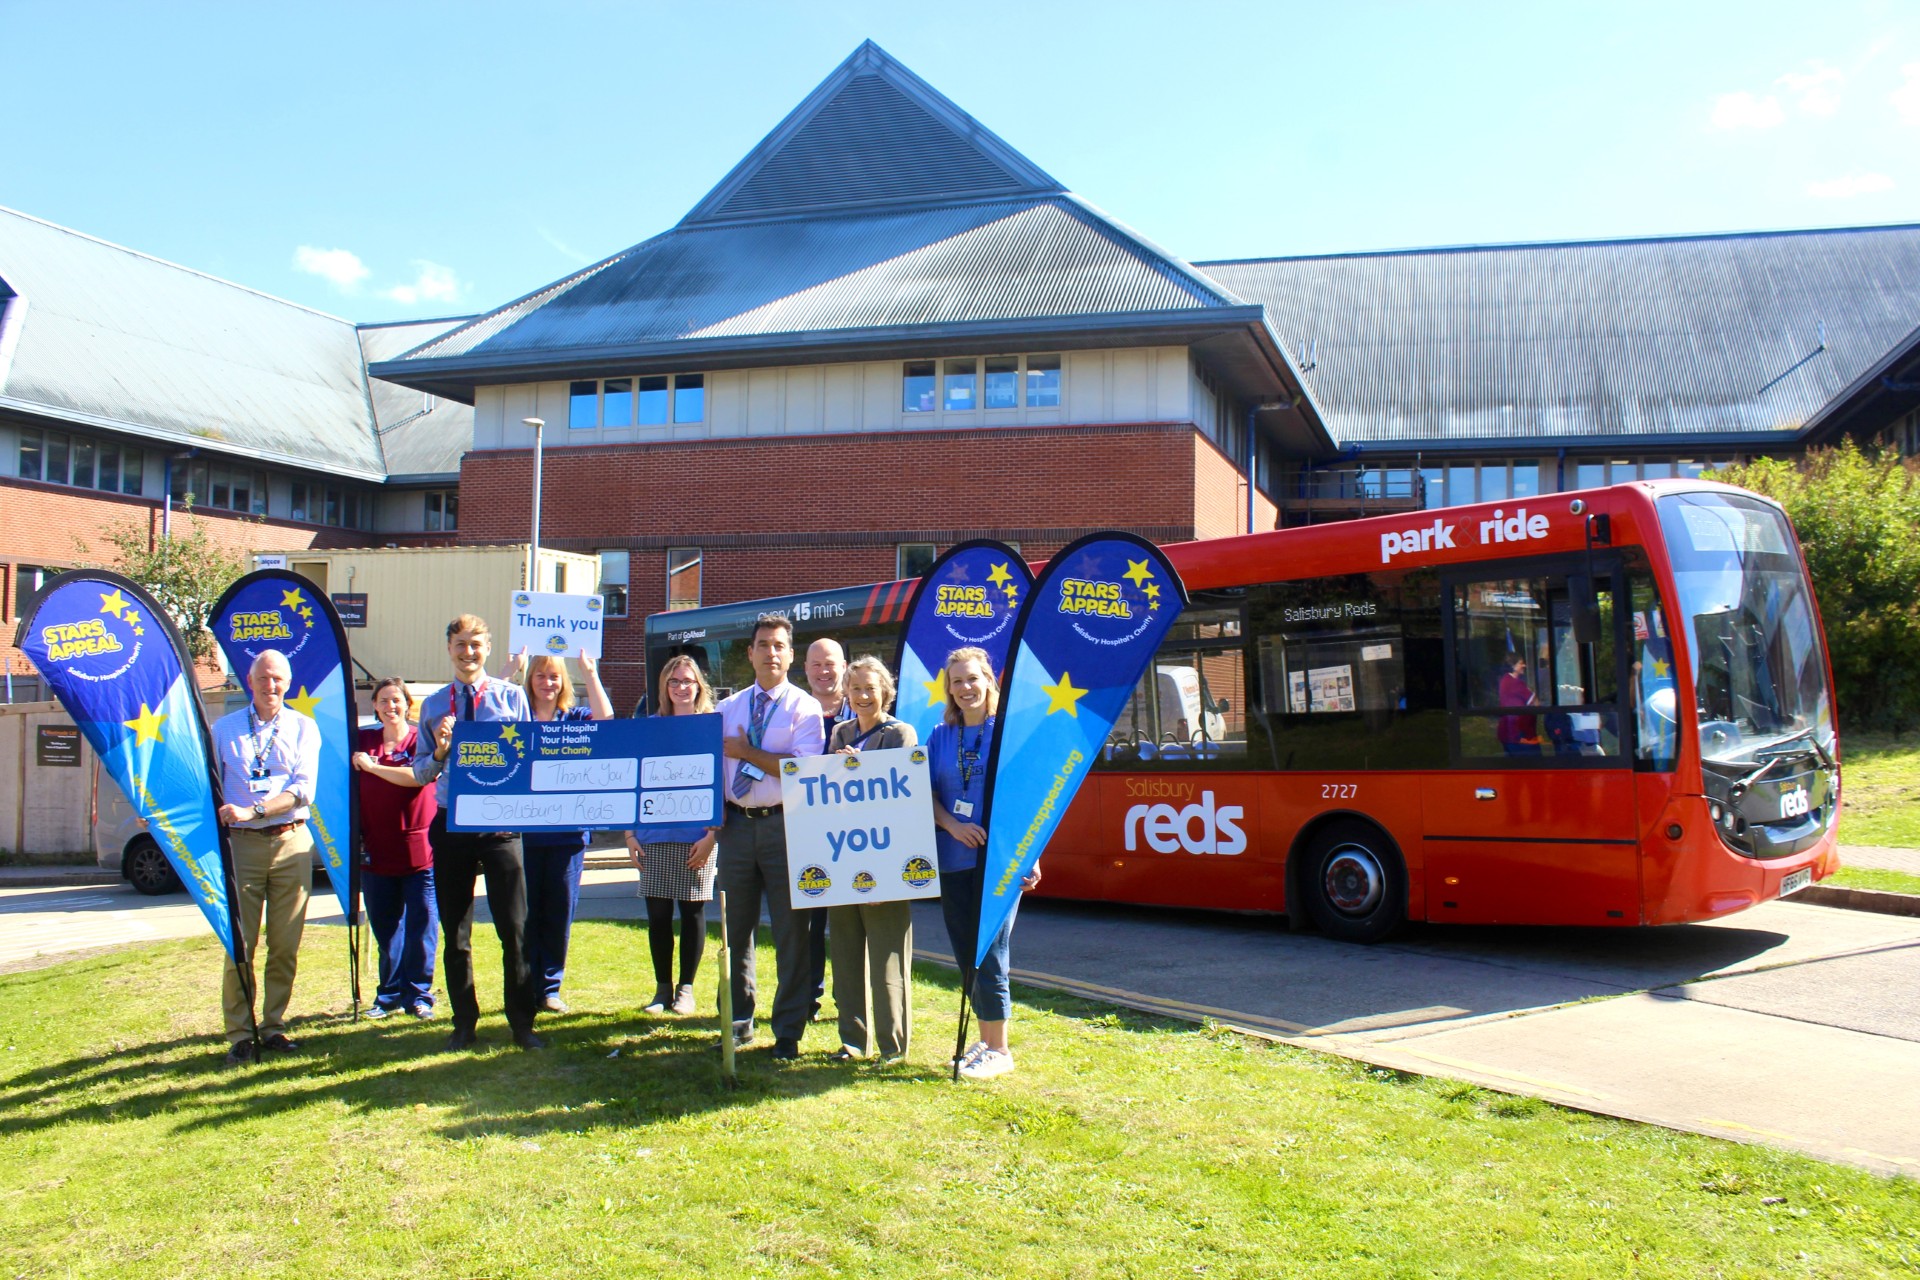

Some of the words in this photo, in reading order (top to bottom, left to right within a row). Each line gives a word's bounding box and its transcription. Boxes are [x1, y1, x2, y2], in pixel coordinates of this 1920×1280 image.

[1380, 518, 1456, 563] park
[1479, 508, 1549, 545] ride
[937, 586, 985, 602] STARS
[1062, 579, 1120, 600] STARS
[792, 602, 811, 621] 15
[813, 600, 845, 619] mins
[936, 600, 993, 617] APPEAL
[1060, 596, 1131, 618] APPEAL
[1284, 606, 1342, 622] Salisbury
[1344, 601, 1377, 617] Reds
[231, 612, 280, 628] STARS
[517, 613, 565, 629] Thank
[570, 619, 599, 633] you
[945, 623, 968, 643] Salisbury
[968, 631, 997, 643] Hospital's
[995, 612, 1013, 633] Charity
[1072, 622, 1100, 645] Salisbury
[1100, 634, 1135, 646] Hospital's
[1133, 614, 1154, 636] Charity
[44, 619, 105, 644] STARS
[232, 624, 291, 640] APPEAL
[295, 632, 311, 651] Charity
[667, 632, 678, 640] Part
[677, 631, 683, 639] of
[49, 635, 122, 660] APPEAL
[67, 666, 99, 682] Salisbury
[99, 663, 131, 681] Hospital's
[128, 641, 143, 664] Charity
[540, 735, 560, 744] Your
[561, 734, 590, 744] Health
[541, 724, 561, 733] Your
[562, 723, 598, 734] Hospital
[459, 743, 498, 755] STARS
[540, 746, 559, 755] Your
[561, 746, 592, 756] Charity
[458, 754, 506, 766] APPEAL
[548, 762, 594, 785] Thank
[798, 766, 912, 807] Thank
[1125, 778, 1195, 801] Salisbury
[1321, 784, 1358, 799] 2727
[481, 795, 562, 824] Salisbury
[573, 795, 615, 821] Reds
[1780, 784, 1809, 818] reds
[992, 748, 1084, 897] www.starsappeal.org
[1124, 790, 1247, 855] reds
[132, 773, 220, 905] www.starsappeal.org
[826, 826, 891, 862] you
[797, 878, 832, 890] STARS
[901, 869, 937, 881] STARS
